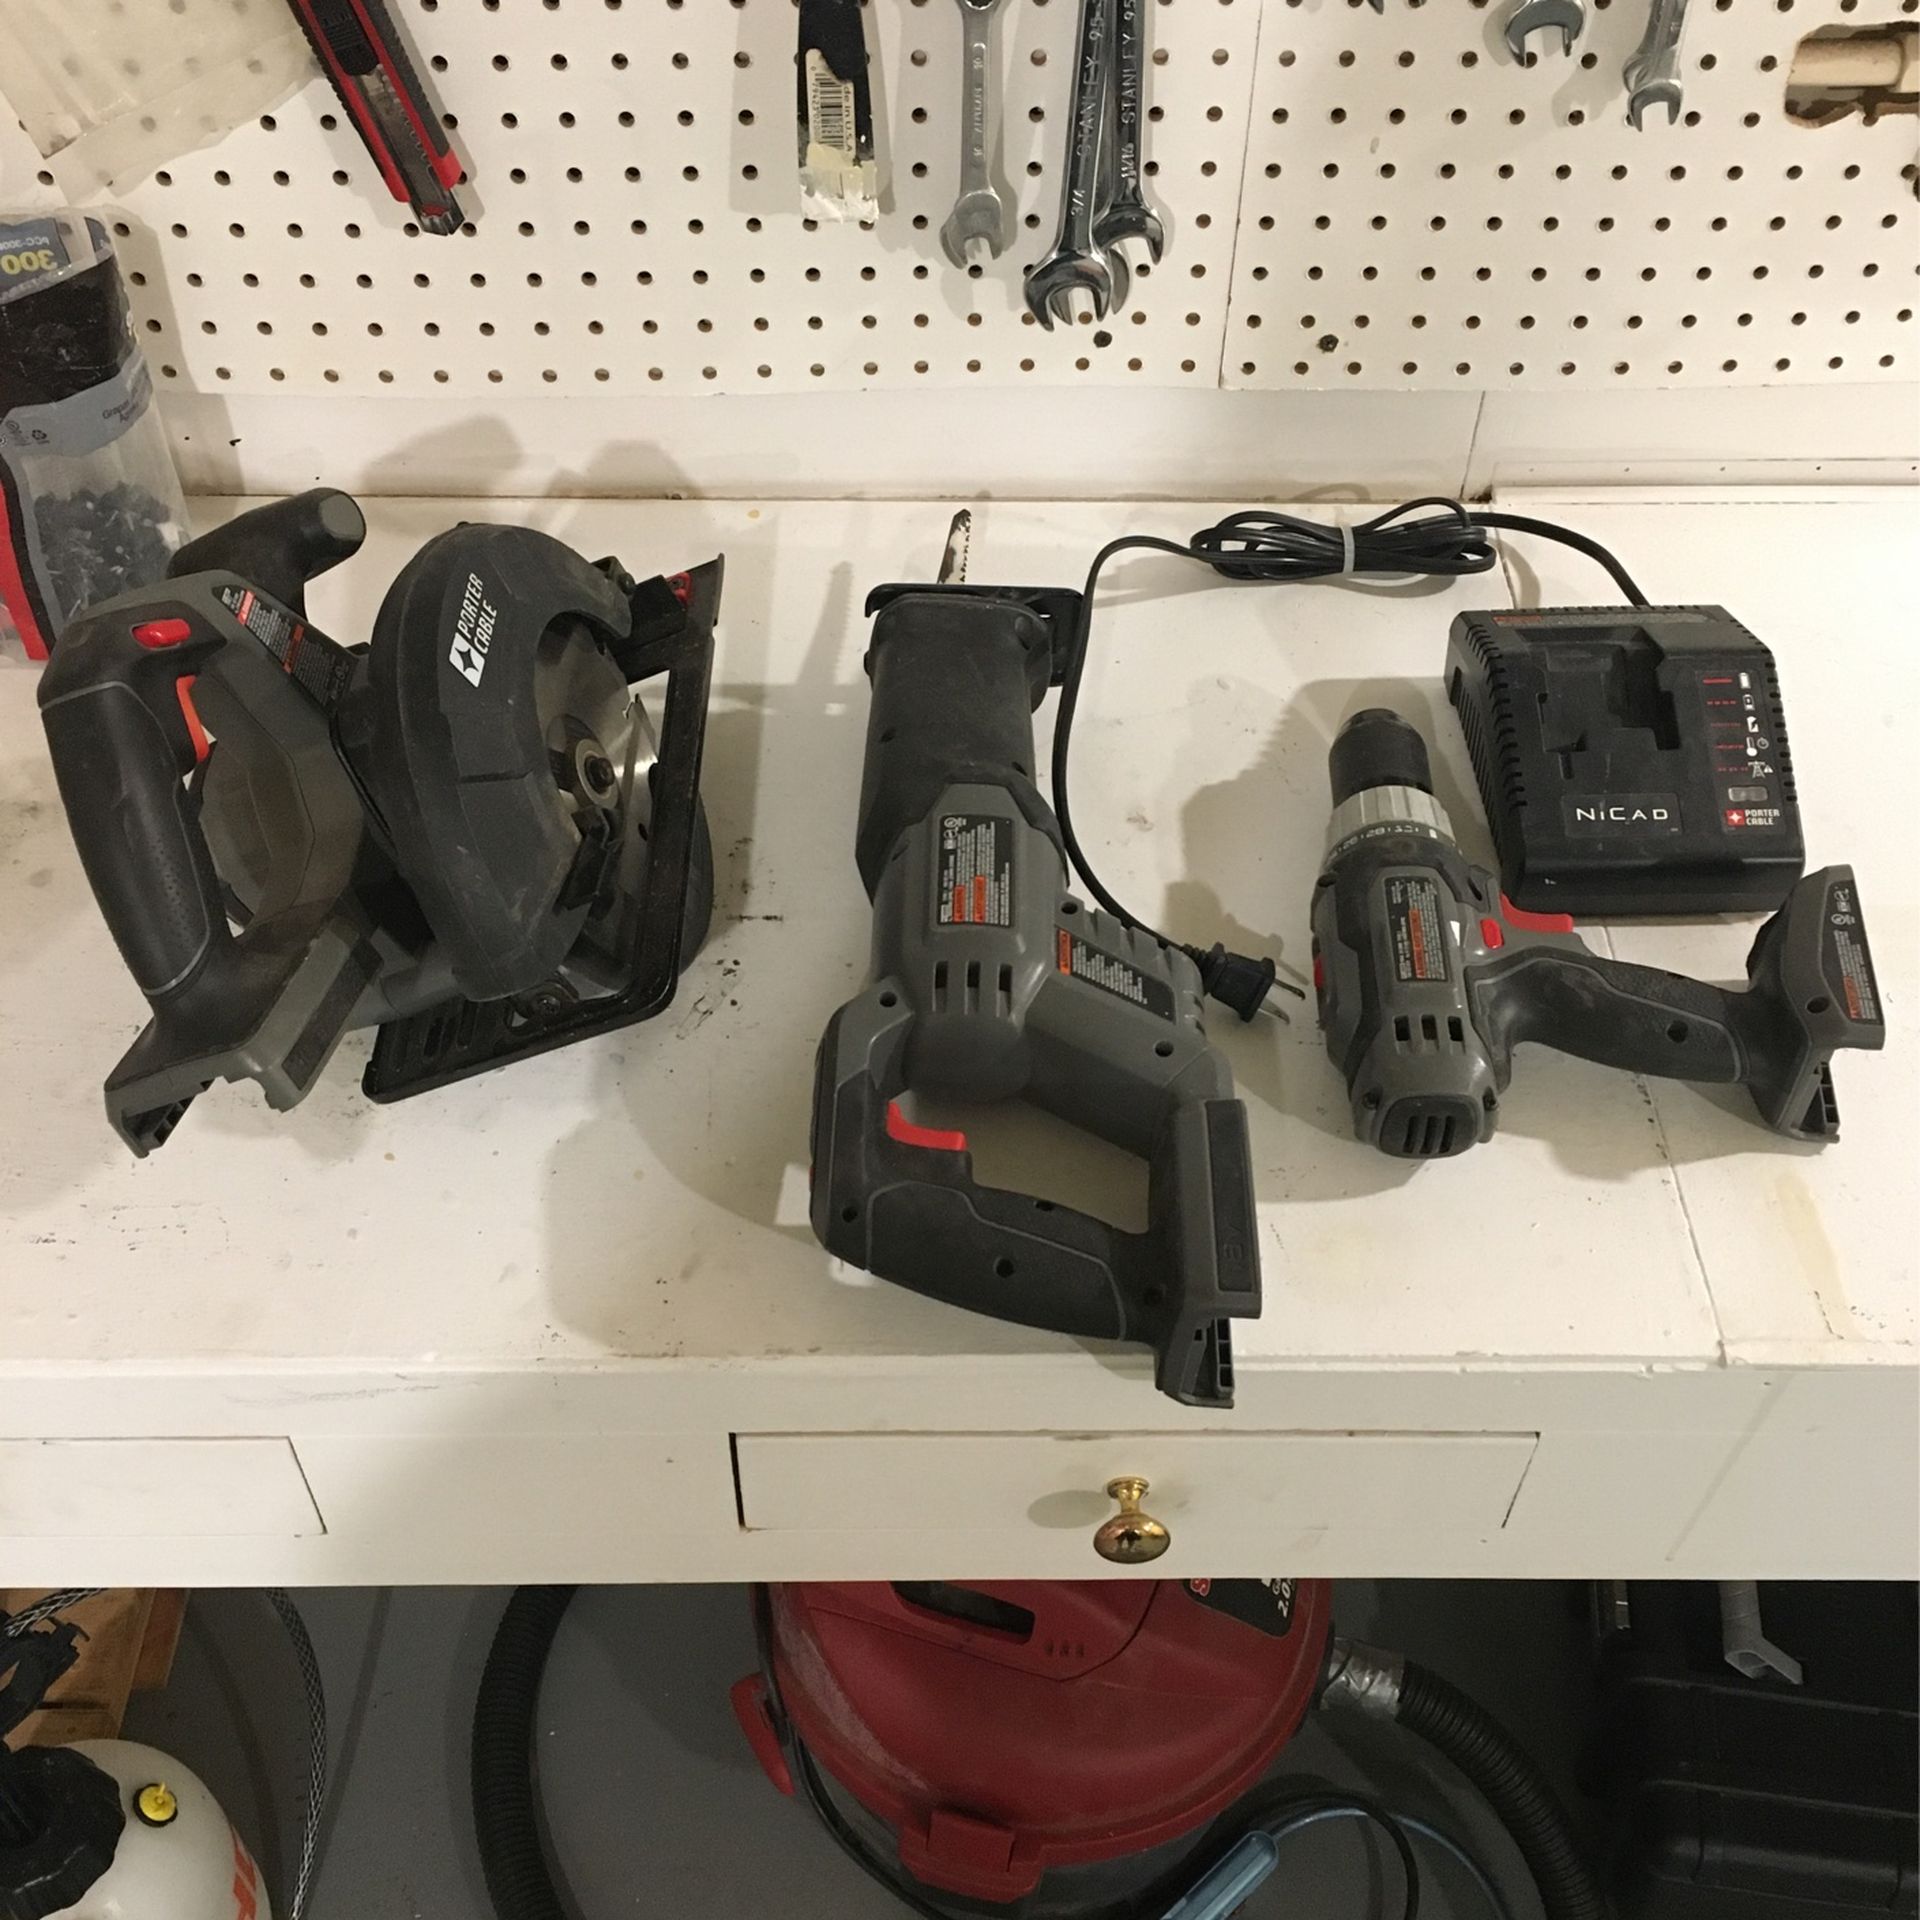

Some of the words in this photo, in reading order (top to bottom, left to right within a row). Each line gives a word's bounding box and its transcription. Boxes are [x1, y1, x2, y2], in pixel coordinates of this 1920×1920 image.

[1076, 55, 1099, 156] STANLEY
[1121, 32, 1137, 124] STANLEY
[1070, 188, 1086, 217] 3/4
[457, 572, 484, 639] PORTER
[474, 599, 498, 654] CABLE
[1744, 808, 1780, 817] PORTER
[1745, 817, 1774, 826] CABLE
